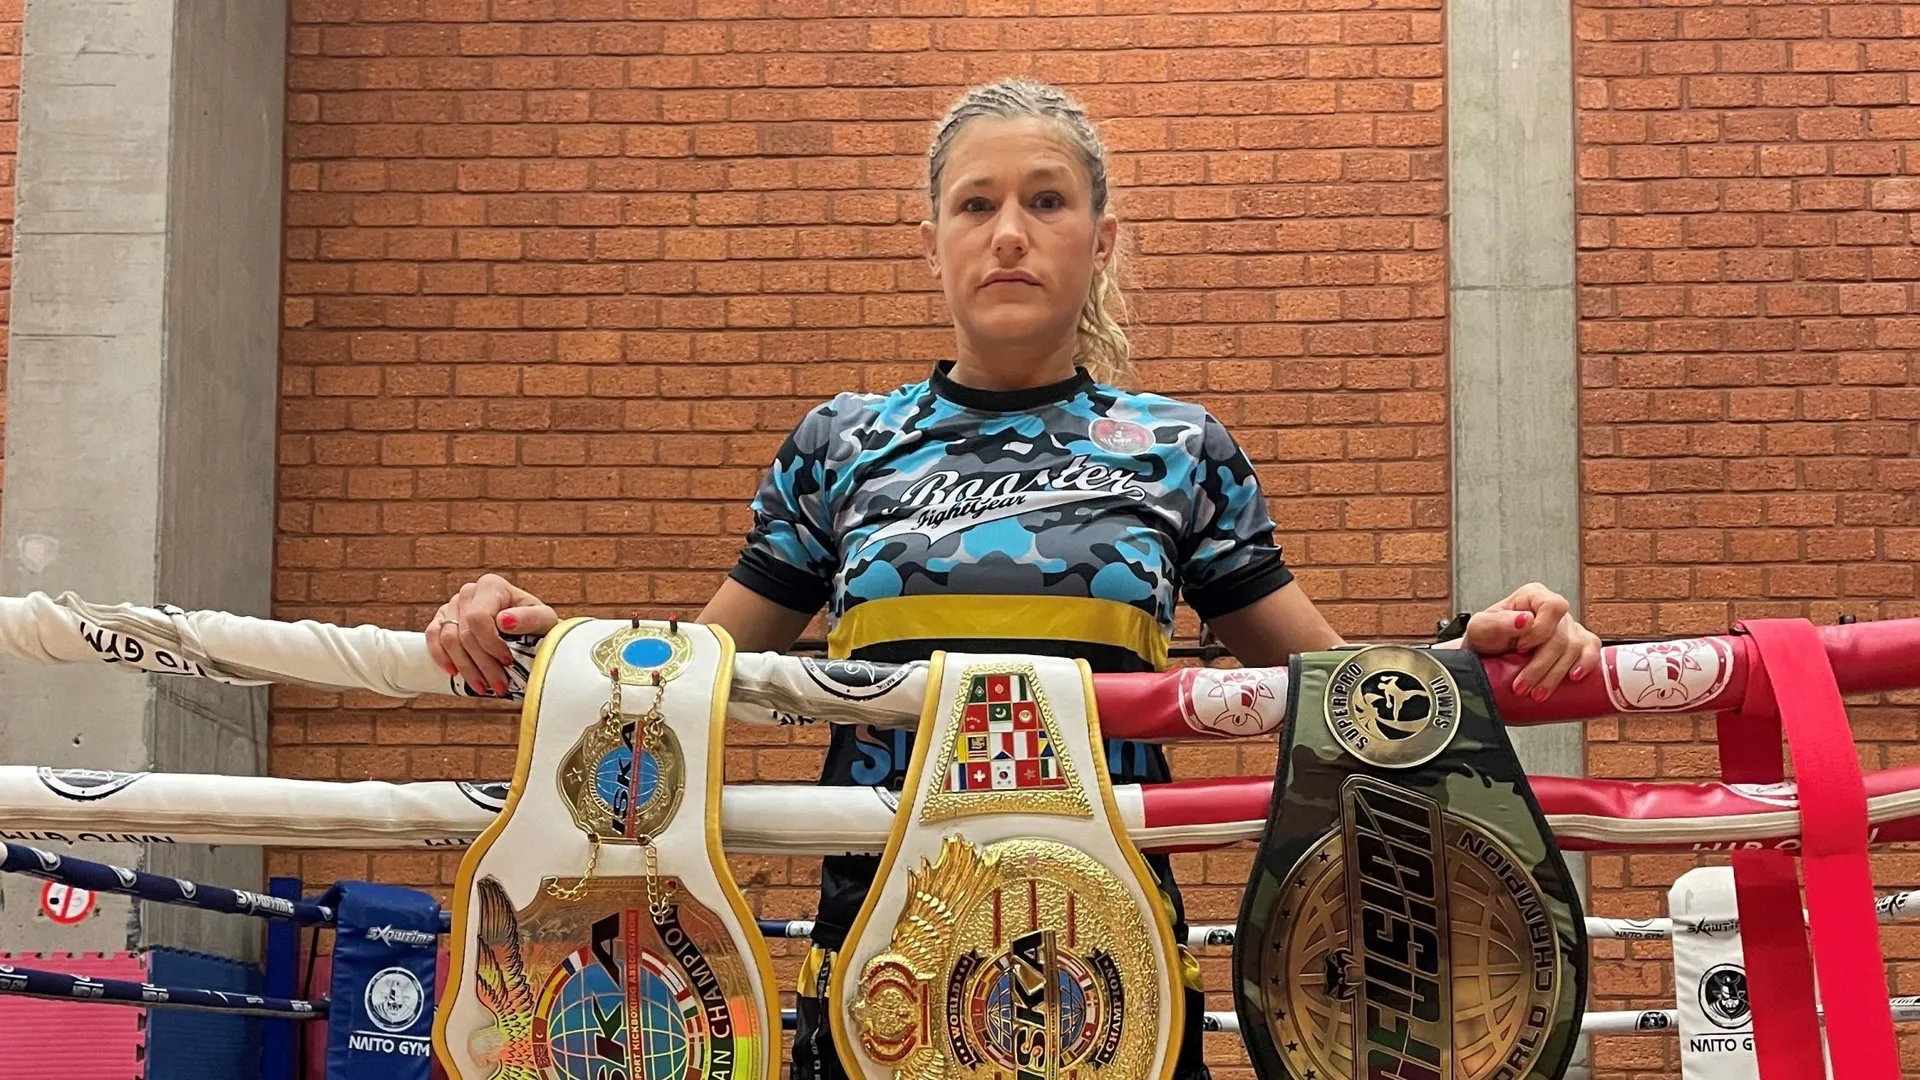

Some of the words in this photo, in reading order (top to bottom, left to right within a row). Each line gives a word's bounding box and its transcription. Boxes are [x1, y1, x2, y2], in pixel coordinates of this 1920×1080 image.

[899, 454, 1146, 507] Booster
[1331, 662, 1369, 751] SUPERPRO
[1429, 675, 1454, 730] SAMUI
[611, 721, 636, 836] ISKA
[1456, 829, 1554, 993] CHAMPION
[628, 985, 641, 1049] KICKBOXING
[949, 982, 961, 1039] WORLD
[1105, 967, 1122, 1052] CHAMPION
[348, 1035, 395, 1053] NAITO
[399, 1041, 430, 1057] GYM
[1690, 1038, 1737, 1053] NAITO
